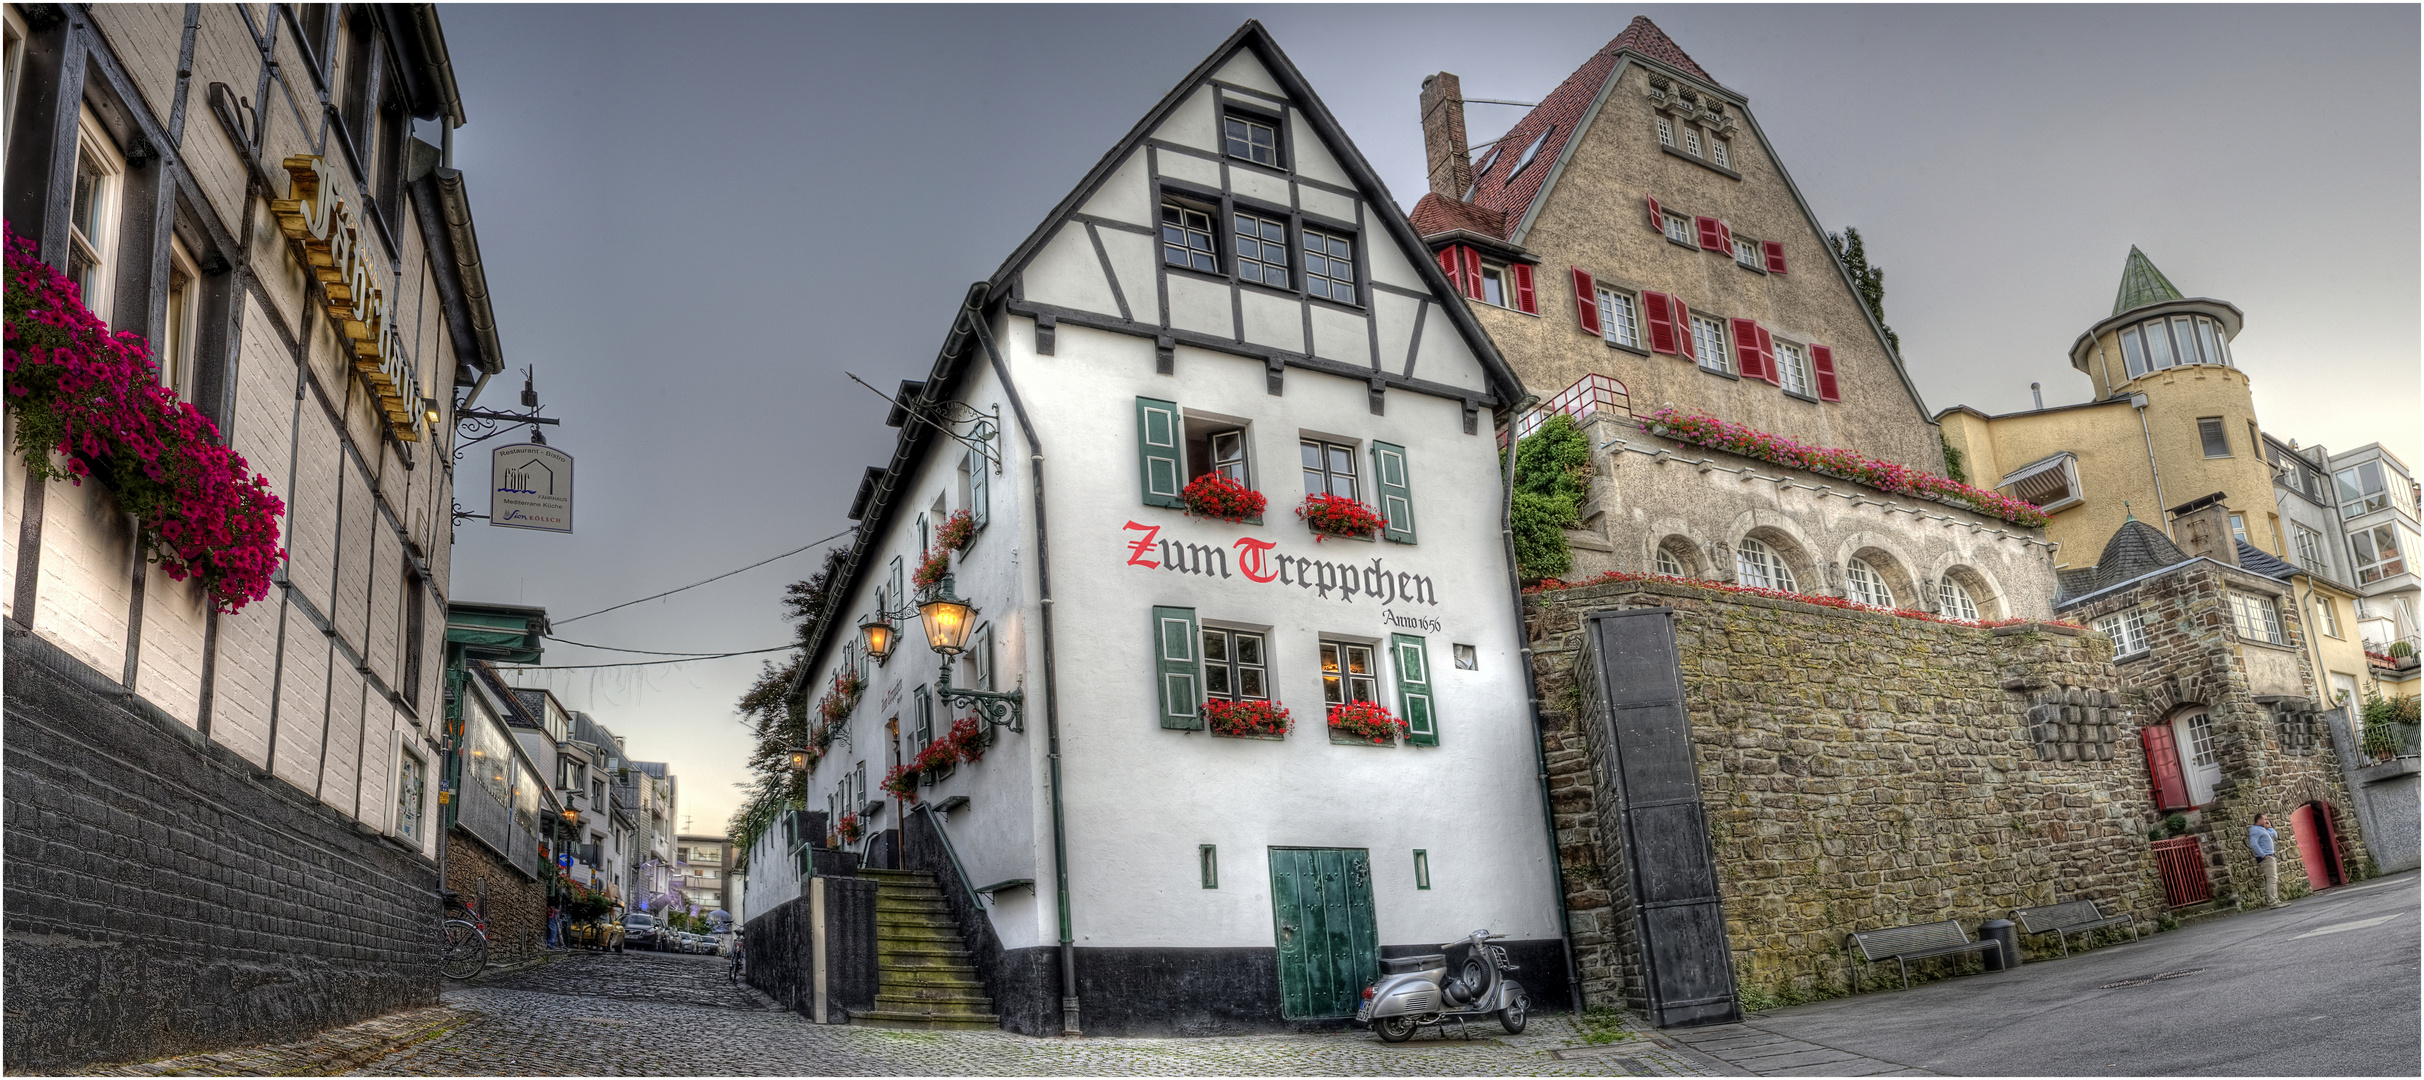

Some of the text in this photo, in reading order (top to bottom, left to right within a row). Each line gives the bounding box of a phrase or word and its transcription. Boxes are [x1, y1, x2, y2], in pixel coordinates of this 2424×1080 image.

[500, 448, 539, 456] Restaurant
[545, 451, 566, 462] Bistro
[503, 498, 541, 507] Mediterrane
[1122, 519, 1439, 607] Zum Treppchen
[1382, 608, 1441, 634] Anno 1656
